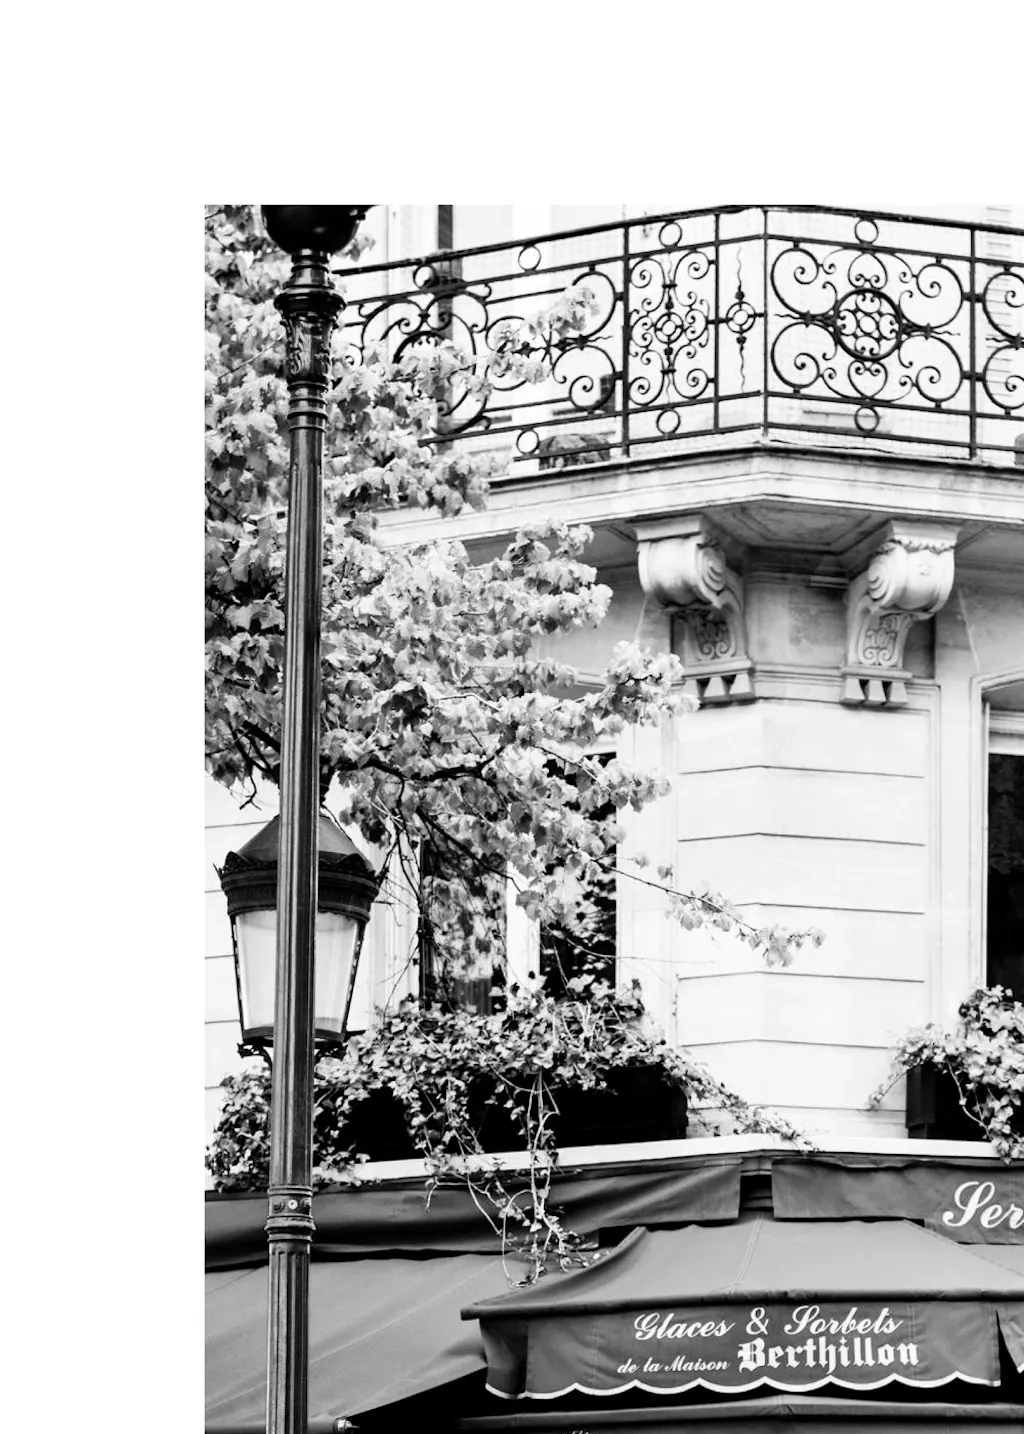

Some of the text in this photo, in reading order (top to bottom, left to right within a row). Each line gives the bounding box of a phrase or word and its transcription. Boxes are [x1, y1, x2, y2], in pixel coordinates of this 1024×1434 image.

[634, 1305, 903, 1340] Glaces & Sorbets
[617, 1336, 919, 1374] de la Maison Berthillon
